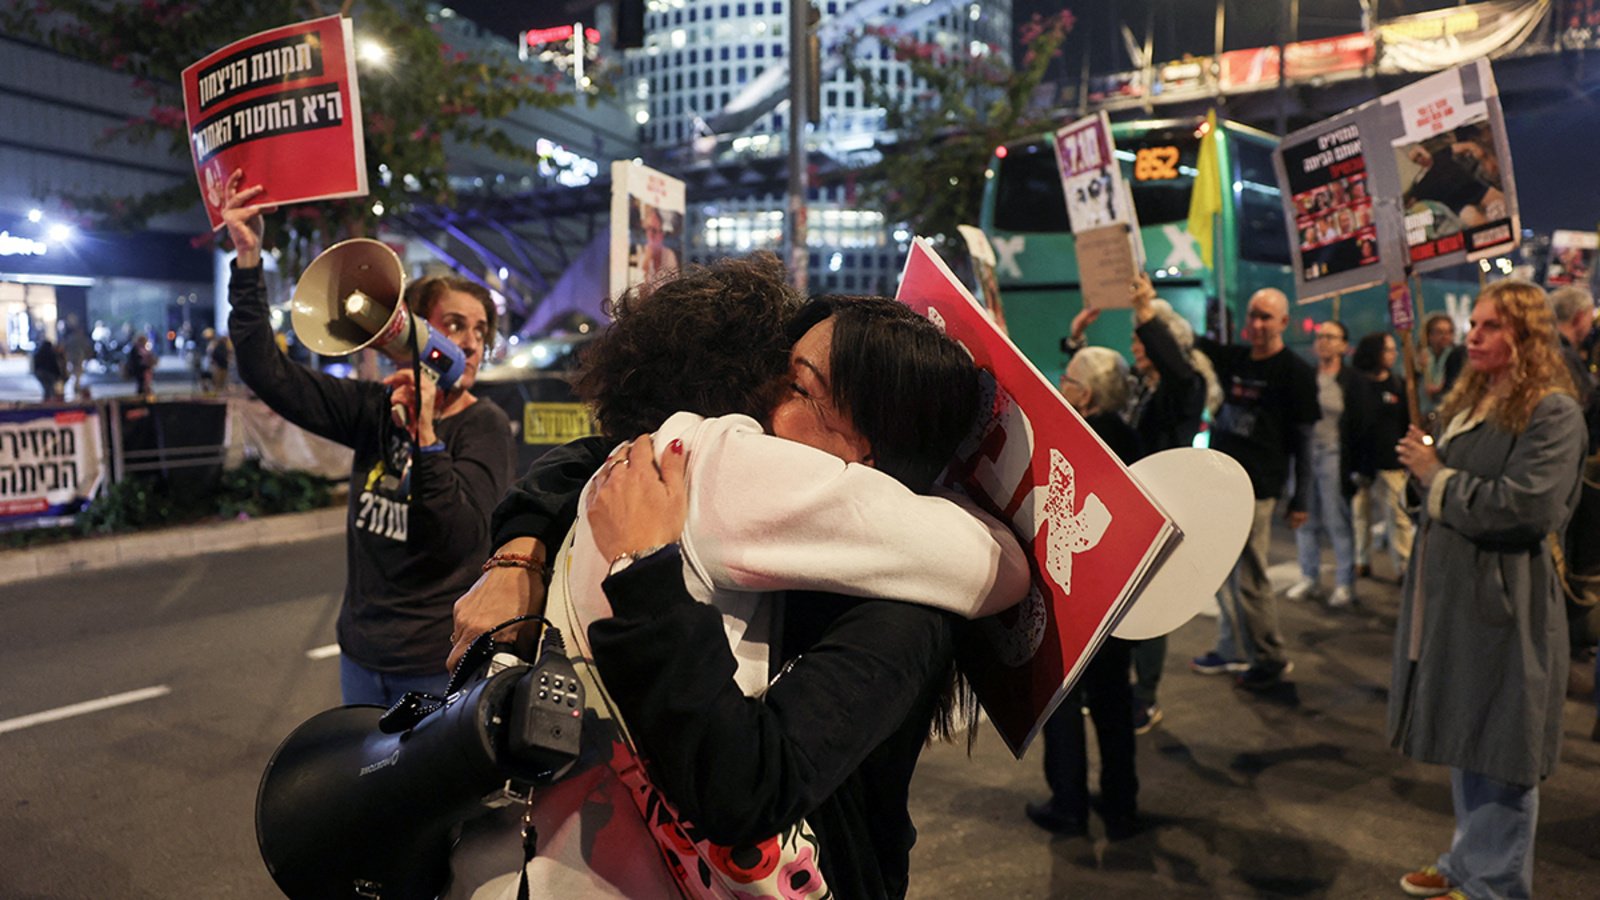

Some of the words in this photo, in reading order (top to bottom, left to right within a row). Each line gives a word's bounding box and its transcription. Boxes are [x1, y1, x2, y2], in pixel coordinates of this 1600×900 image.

[251, 43, 312, 82] תמונת
[199, 58, 248, 107] הניצחון
[234, 98, 297, 140] החטוף
[302, 91, 343, 124] היא
[1135, 146, 1179, 181] 852
[0, 428, 75, 459] מחזיר
[0, 461, 78, 496] הביתה
